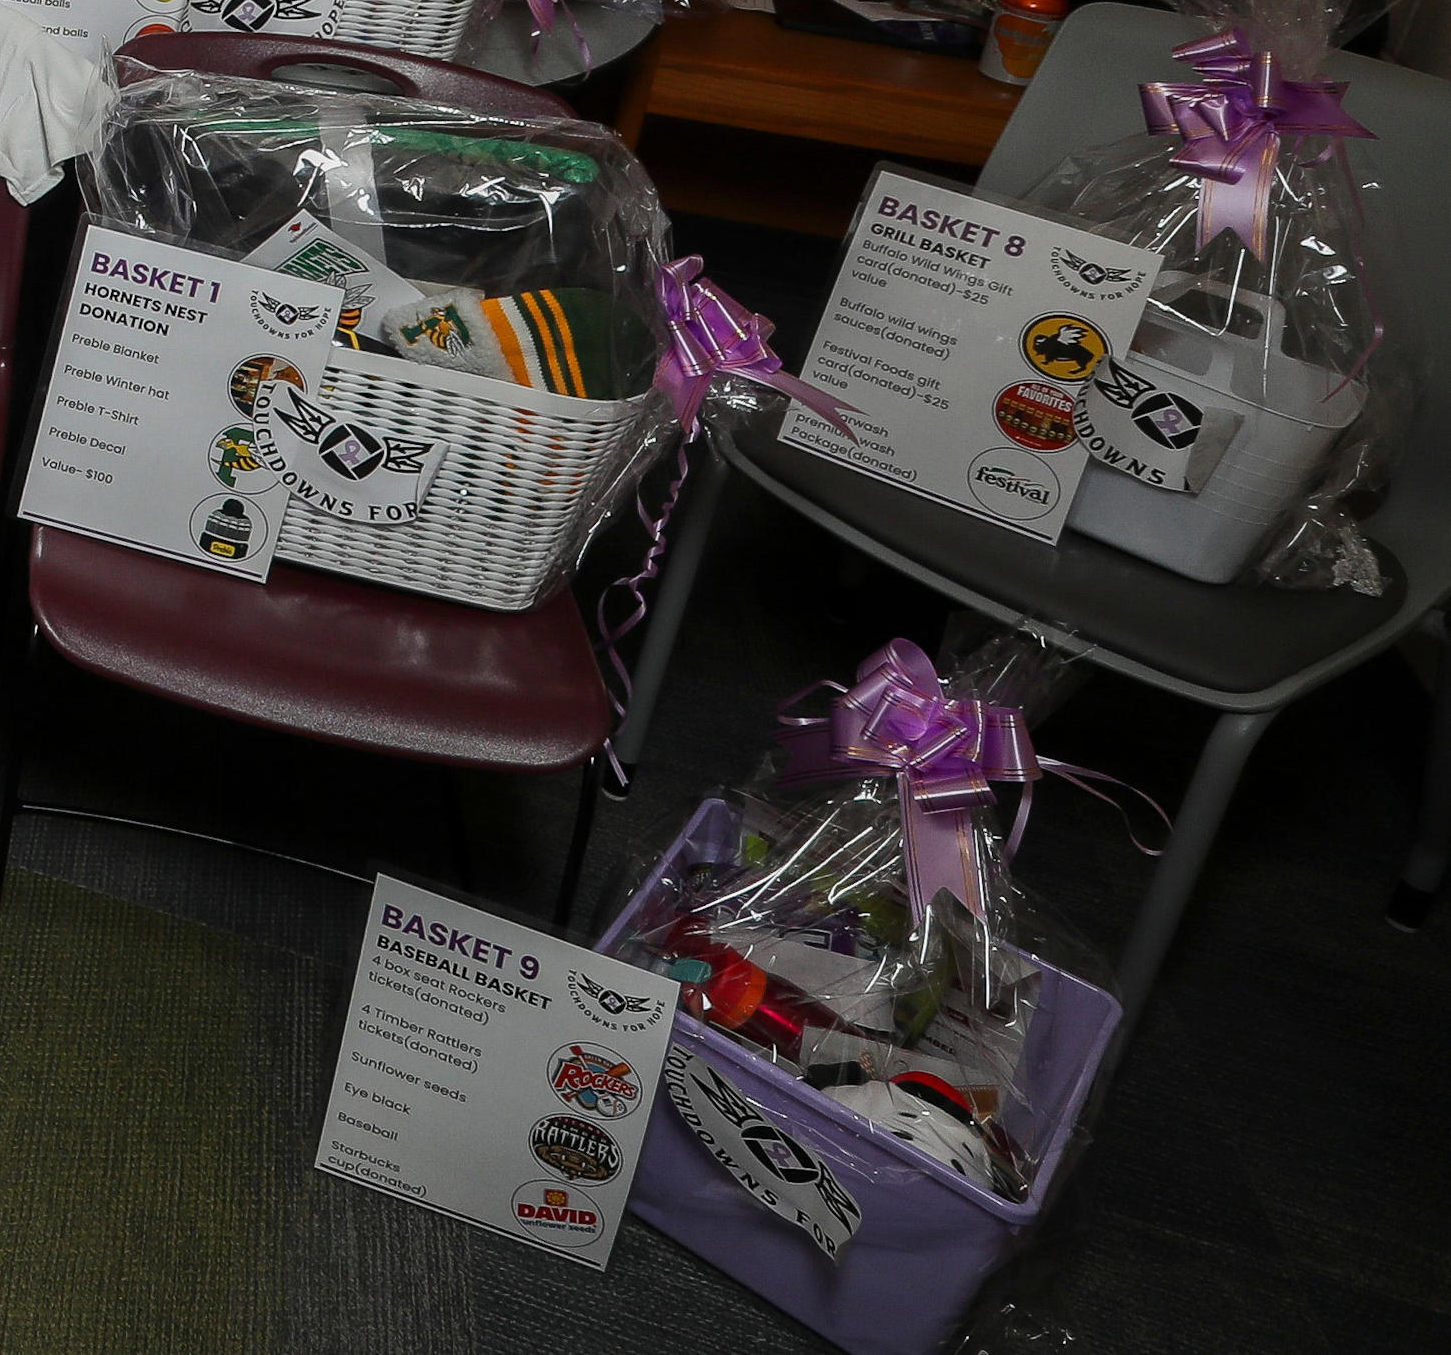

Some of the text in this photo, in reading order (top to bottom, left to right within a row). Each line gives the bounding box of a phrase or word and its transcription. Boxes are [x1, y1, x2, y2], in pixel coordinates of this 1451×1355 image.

[870, 223, 992, 270] GRILL BASKET
[877, 196, 1027, 257] BASKET 8
[90, 252, 222, 303] BASKET 1
[851, 269, 888, 288] value
[857, 255, 989, 306] card(donated)-$25
[863, 239, 1014, 297] Buffalo Wild Wings Gift
[79, 303, 169, 337] DONATION
[84, 282, 208, 325] HORNETS NEST
[249, 289, 332, 341] TOUCHDOWNS FOR HOPE
[840, 297, 958, 346] Buffalo wild wings
[71, 333, 160, 365] Preble Blanket
[834, 312, 950, 361] sauces(donated)
[64, 364, 169, 401] Preble Winter hat
[812, 370, 848, 390] value
[817, 355, 950, 411] card(donated)-$25
[822, 340, 941, 391] Festival Foods gift
[56, 395, 139, 426] Preble T-Shirt
[1017, 386, 1073, 413] FAVORITES
[49, 426, 126, 456] Preble Decal
[252, 383, 419, 520] TOUCHDOWNS FOR
[791, 426, 918, 483] Package(donated)
[41, 456, 114, 485] Value- $100
[975, 466, 1050, 505] festival
[381, 904, 541, 980] BASKET 9
[371, 955, 506, 1014] 4 box seat Rockers
[377, 934, 553, 1010] BASEBALL BASKET
[368, 971, 490, 1026] tickets(donated)
[358, 1019, 479, 1074] tickets(donated)
[361, 1004, 483, 1057] 4 Timber Rattlers
[344, 1082, 411, 1115] Eye black
[351, 1051, 467, 1102] Sunflower seeds
[554, 1062, 638, 1099] ROCKERS
[338, 1112, 398, 1141] Baseball
[535, 1120, 620, 1168] RATTLERS
[331, 1140, 401, 1173] Starbucks
[665, 1045, 837, 1257] TOUCHDOWNS FOR
[328, 1155, 428, 1198] cup(donated)
[518, 1203, 597, 1225] DAVID
